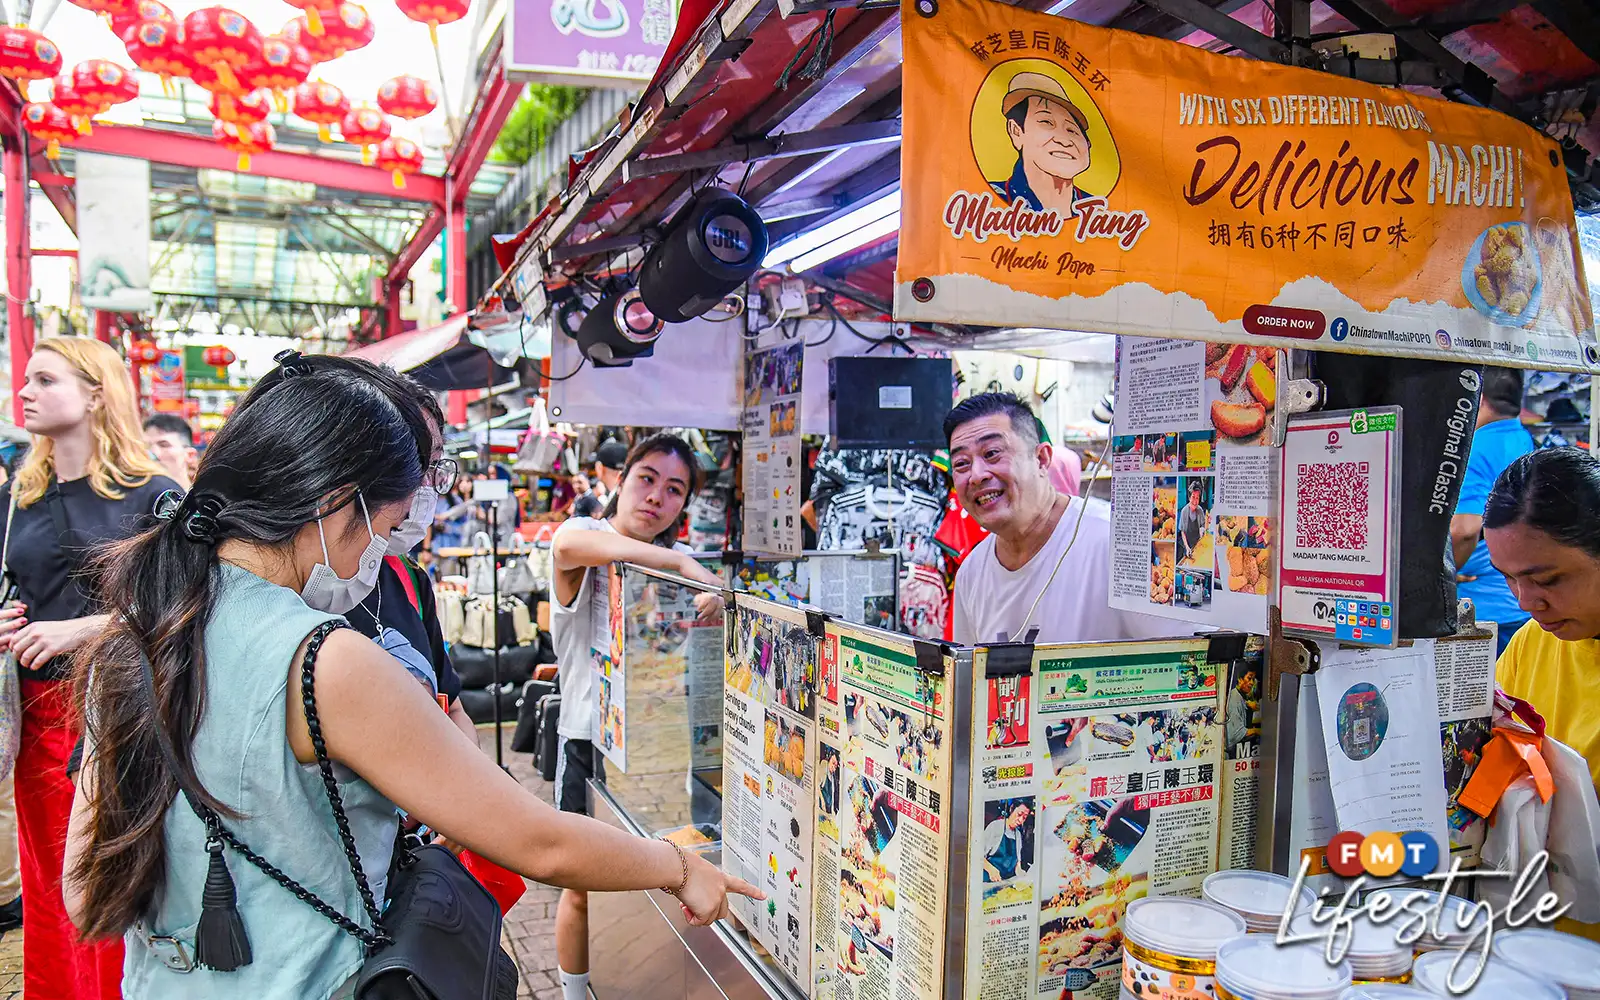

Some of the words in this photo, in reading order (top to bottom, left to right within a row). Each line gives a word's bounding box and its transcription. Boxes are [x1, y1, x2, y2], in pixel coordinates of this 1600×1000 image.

[970, 29, 1111, 93] 麻芝皇后陈玉环
[1179, 93, 1228, 126] WITH
[1233, 95, 1265, 126] SIX
[1268, 94, 1360, 126] DIFFERENT
[1183, 135, 1420, 216] Delicious
[944, 192, 1062, 241] Madam
[1073, 198, 1148, 248] Tang
[1208, 217, 1409, 251] 拥有6种不同口味
[712, 227, 747, 251] JBL
[991, 246, 1048, 272] Machi
[1056, 251, 1096, 279] Popo
[1257, 315, 1285, 327] ORDER
[1287, 317, 1314, 329] NOW
[1349, 325, 1431, 344] ChinatownMachiPOPO
[1443, 397, 1473, 460] Original
[1428, 460, 1458, 515] Classic
[1325, 578, 1354, 586] NATIONAL
[725, 689, 741, 711] Serving
[1090, 764, 1213, 797] 麻芝皇后陳玉環
[1235, 761, 1247, 772] 50
[1137, 787, 1212, 810] 獨門手藝不傳人
